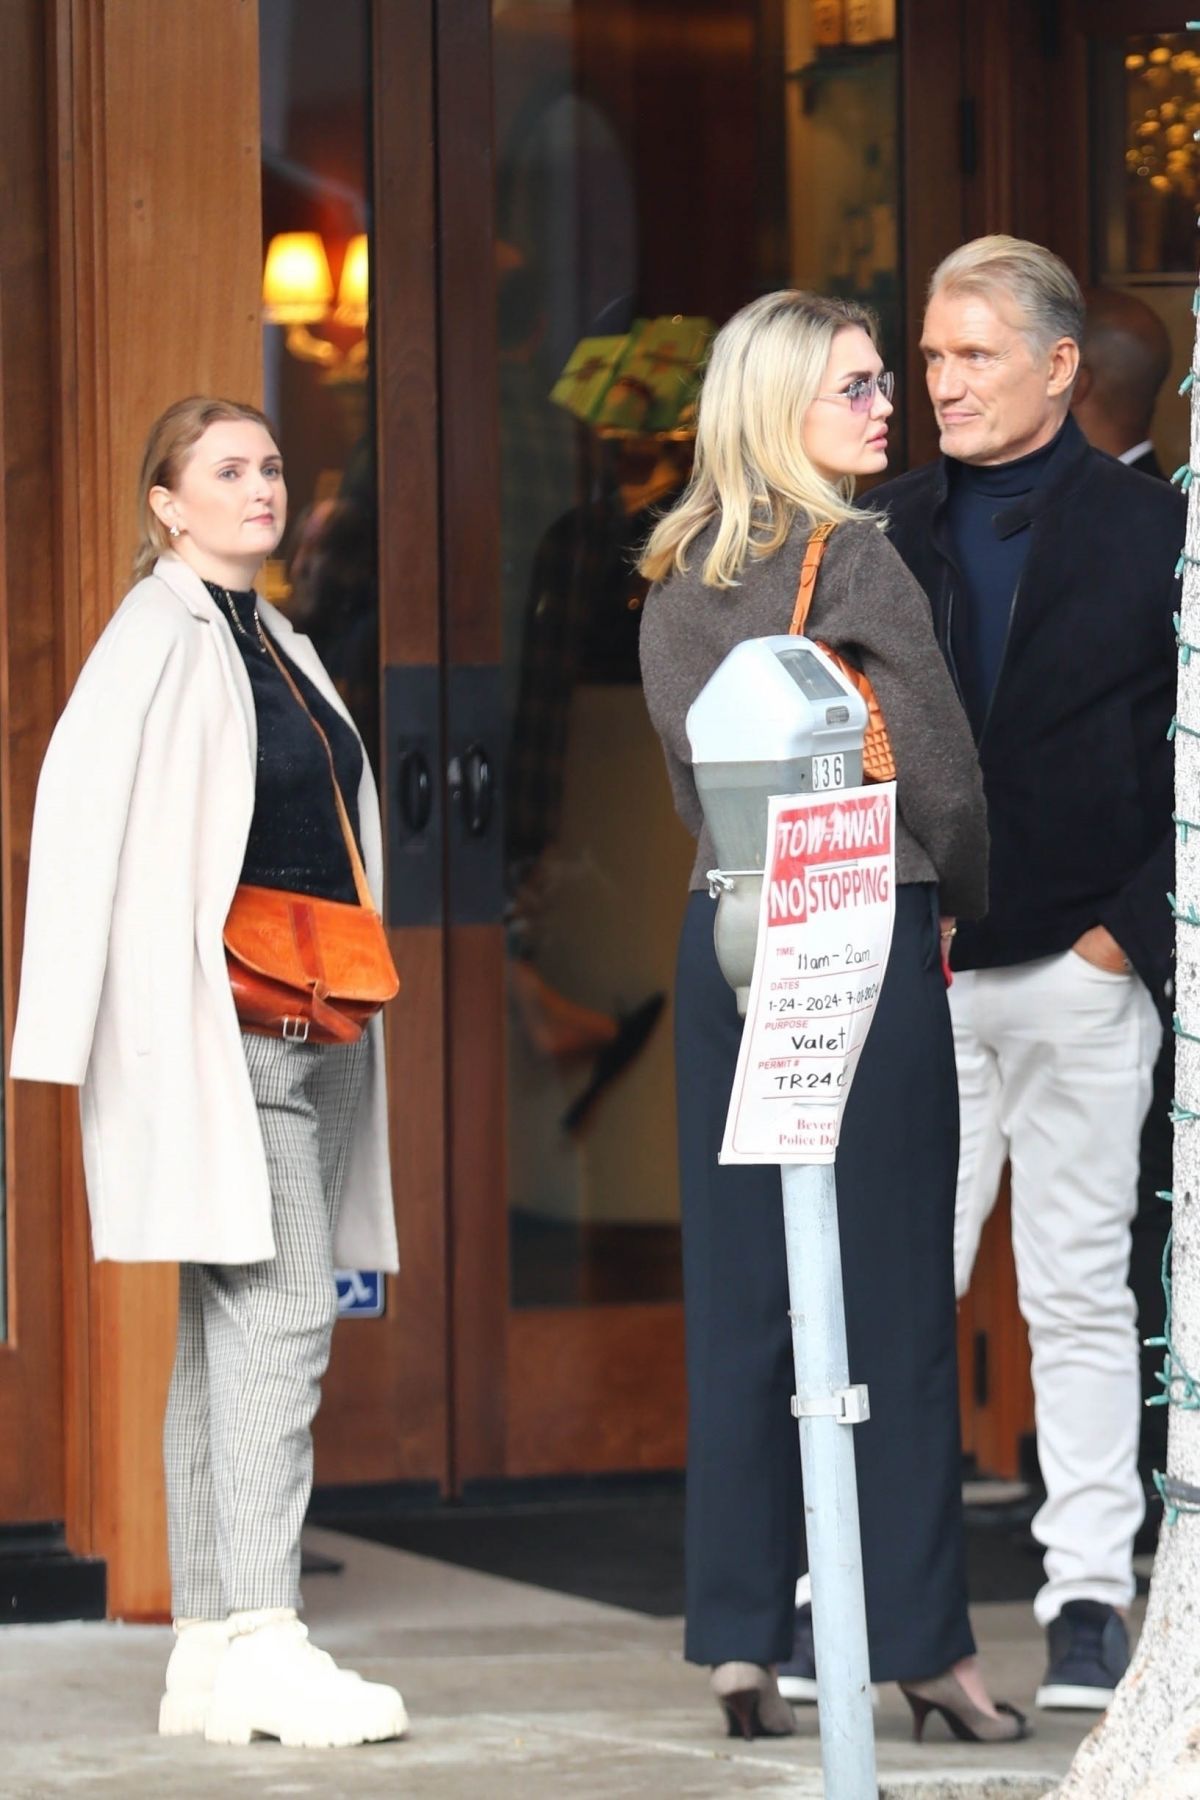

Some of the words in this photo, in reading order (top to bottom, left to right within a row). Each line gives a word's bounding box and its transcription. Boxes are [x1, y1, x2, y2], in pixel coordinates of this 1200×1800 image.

[814, 756, 843, 788] 336
[778, 806, 887, 858] TOW-AWAY
[771, 879, 805, 919] NO
[809, 866, 888, 913] STOPPING
[776, 947, 795, 957] TIME
[798, 954, 830, 970] 11am
[845, 944, 870, 965] 2am
[770, 981, 800, 991] DATES
[764, 1020, 808, 1030] PURPOSE
[791, 1027, 846, 1050] Valet
[758, 1060, 791, 1069] PERMIT
[797, 1119, 837, 1130] Beverl
[779, 1134, 815, 1146] Police
